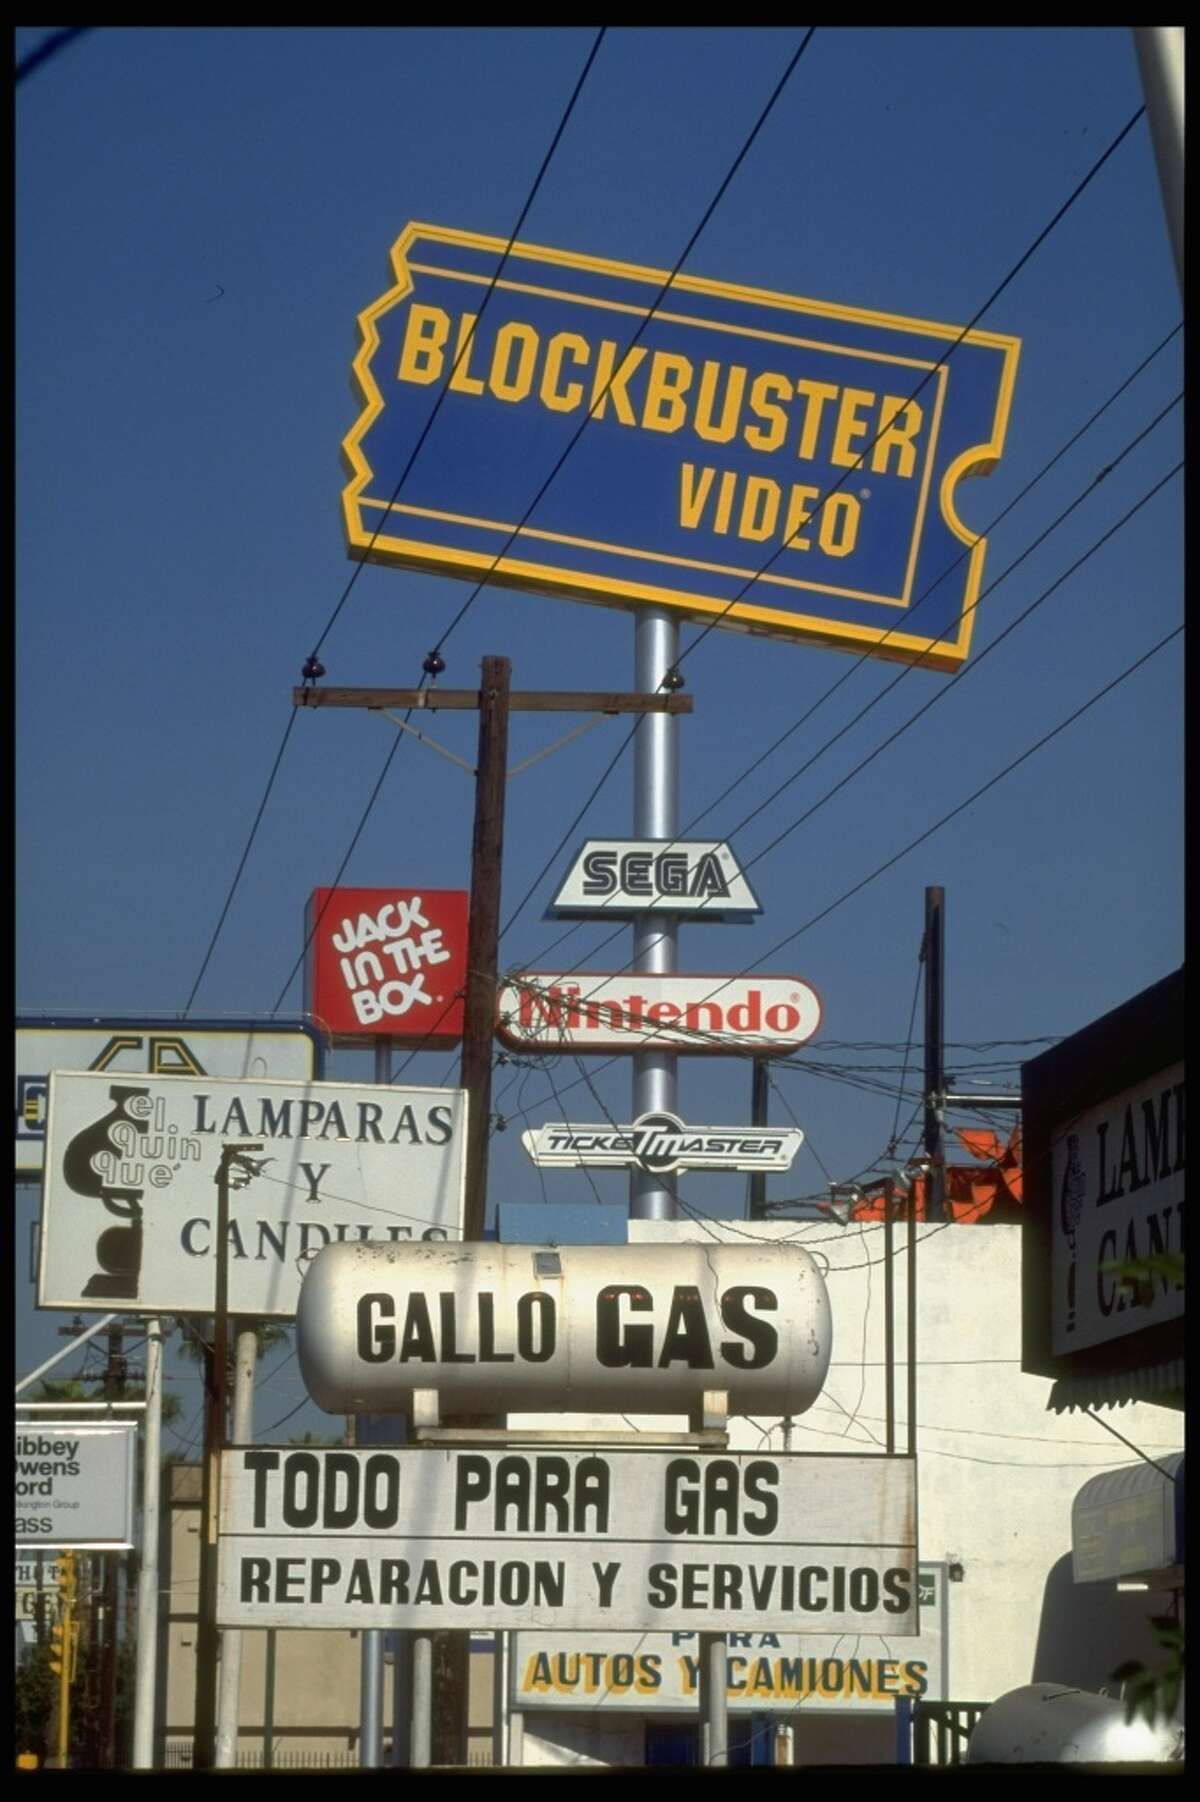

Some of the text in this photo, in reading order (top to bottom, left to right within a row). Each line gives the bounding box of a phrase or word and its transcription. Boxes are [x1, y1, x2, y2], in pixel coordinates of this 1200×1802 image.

[397, 303, 924, 479] BLOCKBUSTER
[679, 462, 862, 558] VIDEO
[583, 851, 731, 898] SEGA
[332, 896, 429, 953] JACK
[382, 928, 451, 974] THE
[351, 972, 433, 1025] BOX
[519, 987, 801, 1032] Nintendo
[193, 1094, 452, 1146] LAMPARAS
[299, 1162, 331, 1203] Y
[357, 1284, 779, 1370] GALLO GAS
[245, 1451, 779, 1535] TODO PARA GAS
[240, 1557, 911, 1614] REPARACION Y SERVICIOS
[671, 1632, 781, 1648] PRA
[531, 1652, 928, 1694] AUTOS Y CAMIONES
